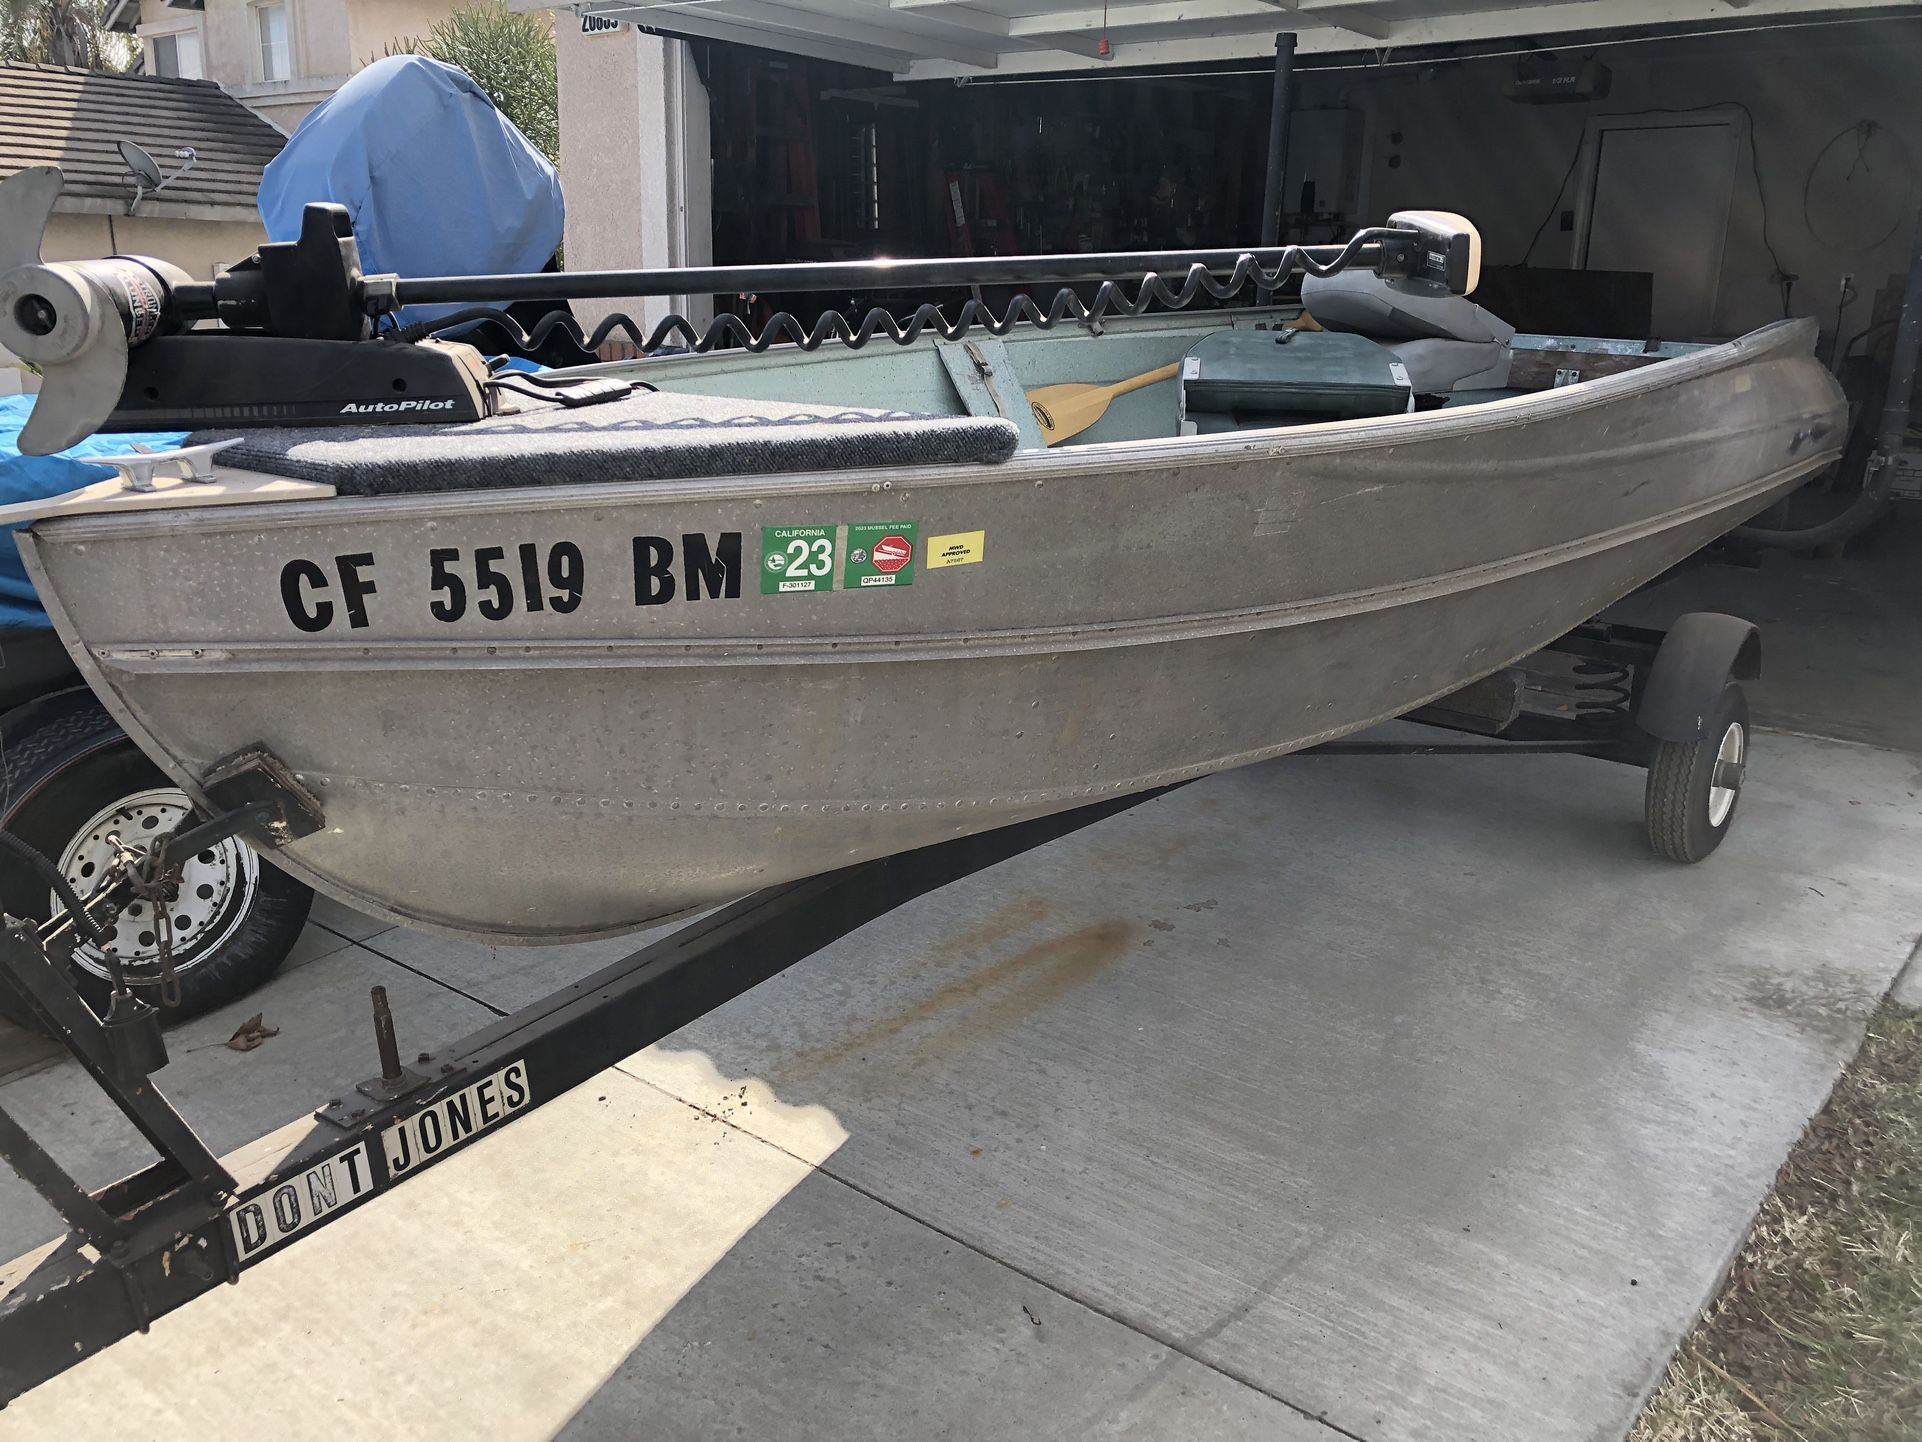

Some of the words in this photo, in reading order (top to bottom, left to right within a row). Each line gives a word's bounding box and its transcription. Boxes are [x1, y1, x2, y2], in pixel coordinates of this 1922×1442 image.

[339, 399, 455, 413] AutoPilot
[775, 529, 826, 538] CALIFORNIA
[785, 538, 832, 577] 23
[941, 549, 971, 557] APPROVED
[280, 551, 377, 632] CF
[429, 541, 584, 623] 5519
[632, 532, 742, 606] BM
[782, 581, 812, 589] F-301127
[862, 576, 893, 584] QP44135
[236, 1147, 361, 1255] DONT
[392, 1065, 526, 1172] JONES
